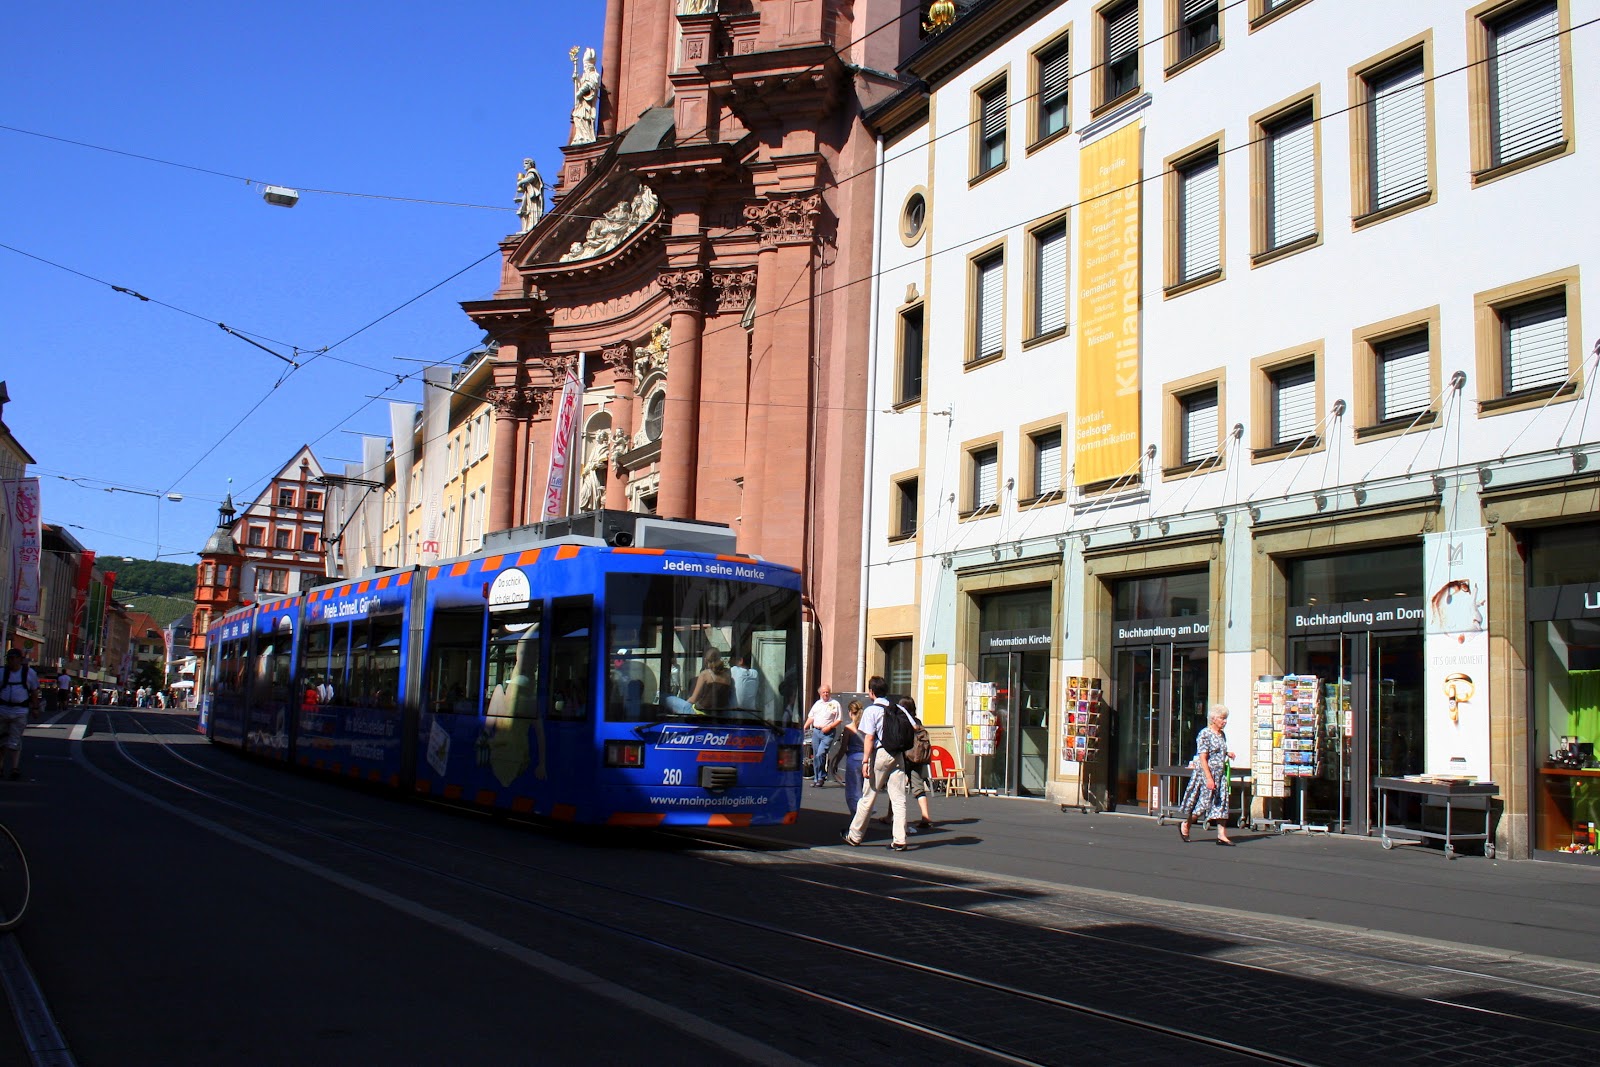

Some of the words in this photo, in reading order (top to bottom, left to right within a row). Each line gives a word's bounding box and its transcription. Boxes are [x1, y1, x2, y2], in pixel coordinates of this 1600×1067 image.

[1091, 218, 1116, 235] Frauen
[1086, 249, 1119, 269] Senioren
[1081, 278, 1117, 299] Gemeinde
[1088, 331, 1114, 347] Mission
[1077, 410, 1105, 427] Kontakt
[1076, 423, 1112, 439] Seelsorge
[1076, 431, 1137, 452] Kommunikation
[663, 560, 702, 572] Jedem
[705, 564, 733, 575] seine
[735, 566, 765, 579] Marke
[1295, 611, 1373, 627] Buchhandlung
[1375, 611, 1394, 621] am
[1396, 607, 1424, 620] Dom
[1118, 625, 1177, 638] Buchhandlung
[1178, 625, 1192, 635] am
[990, 636, 1028, 647] Information
[1028, 634, 1051, 645] Kirche
[662, 731, 695, 745] Main
[663, 768, 682, 785] 260
[650, 796, 768, 808] www.mainpostlogistik.de
